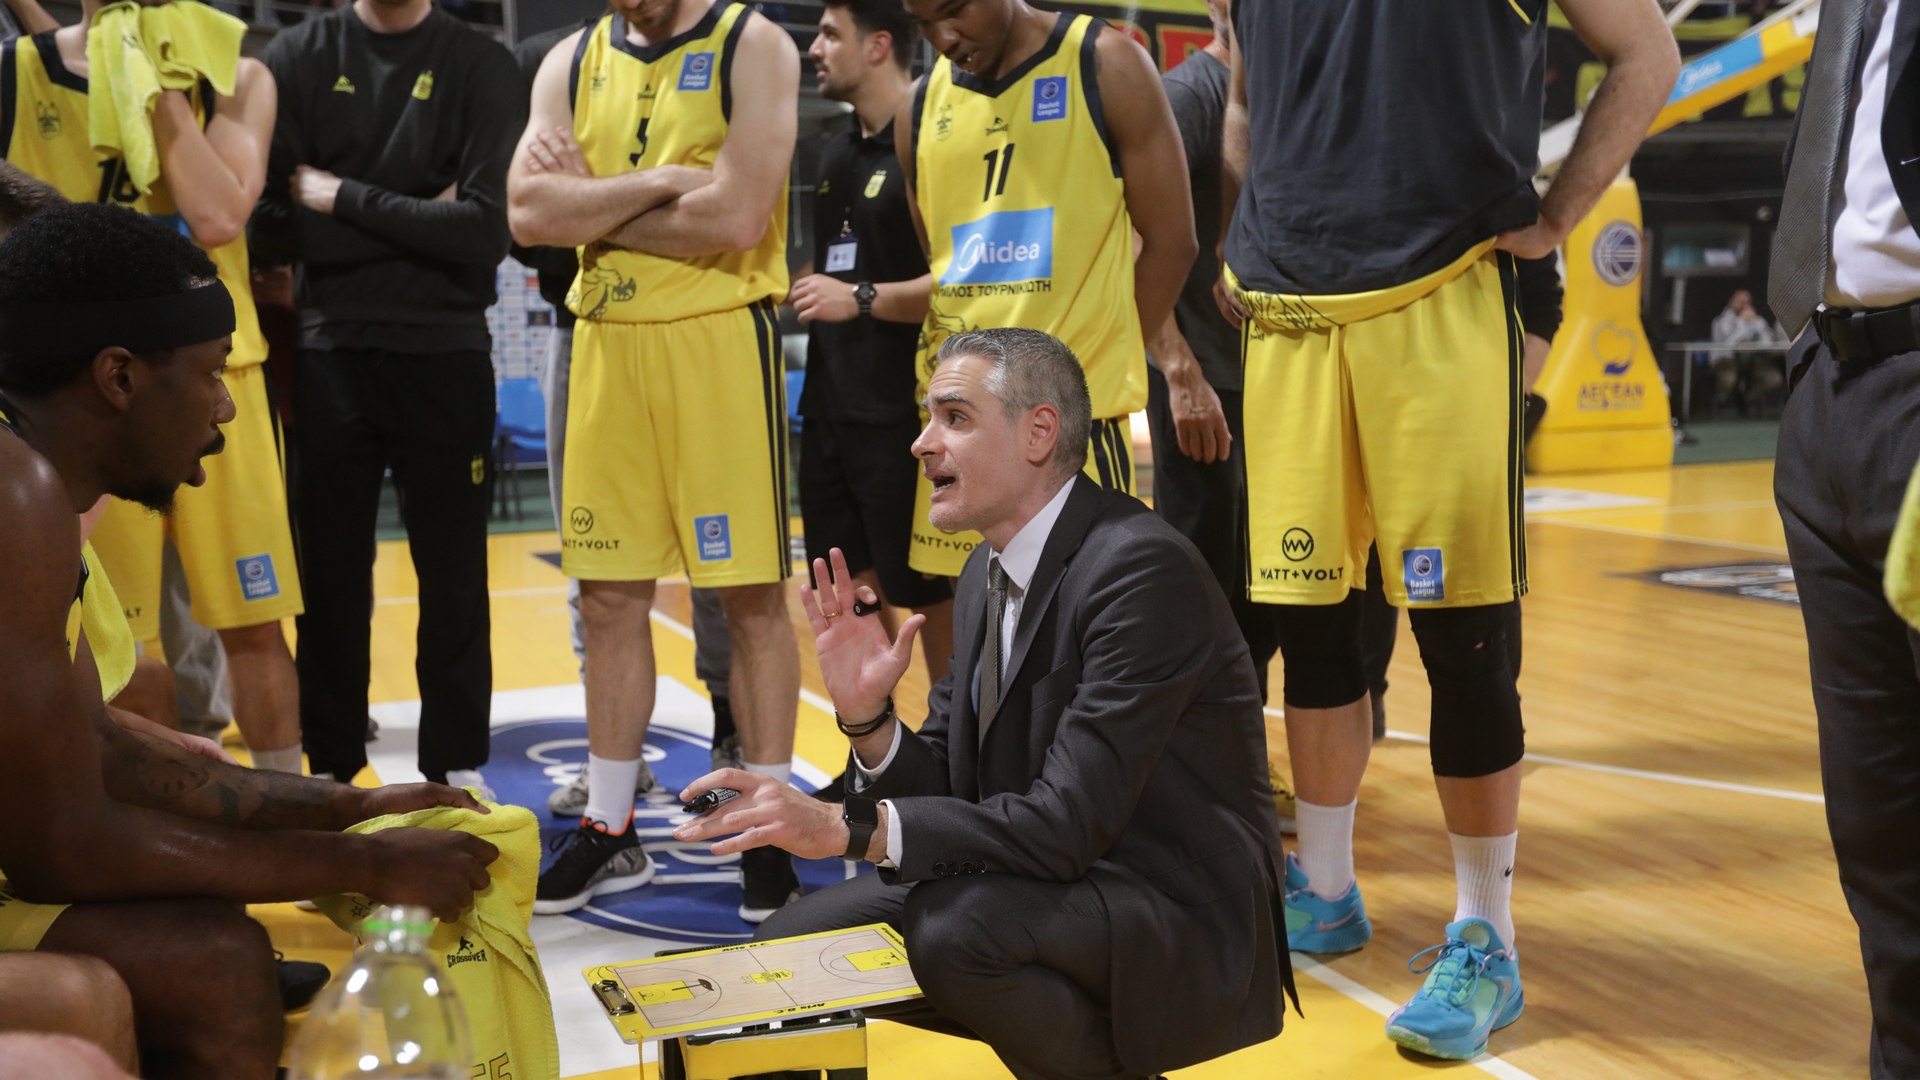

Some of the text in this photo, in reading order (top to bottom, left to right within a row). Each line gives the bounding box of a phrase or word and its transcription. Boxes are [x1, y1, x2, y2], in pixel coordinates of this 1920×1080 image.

[983, 143, 1015, 202] 11
[957, 233, 1040, 272] Midea
[562, 539, 620, 550] ATT+VOLT
[1260, 567, 1344, 581] WATT+VOLT
[1410, 579, 1435, 588] Basket
[447, 949, 487, 968] CROSSOVER
